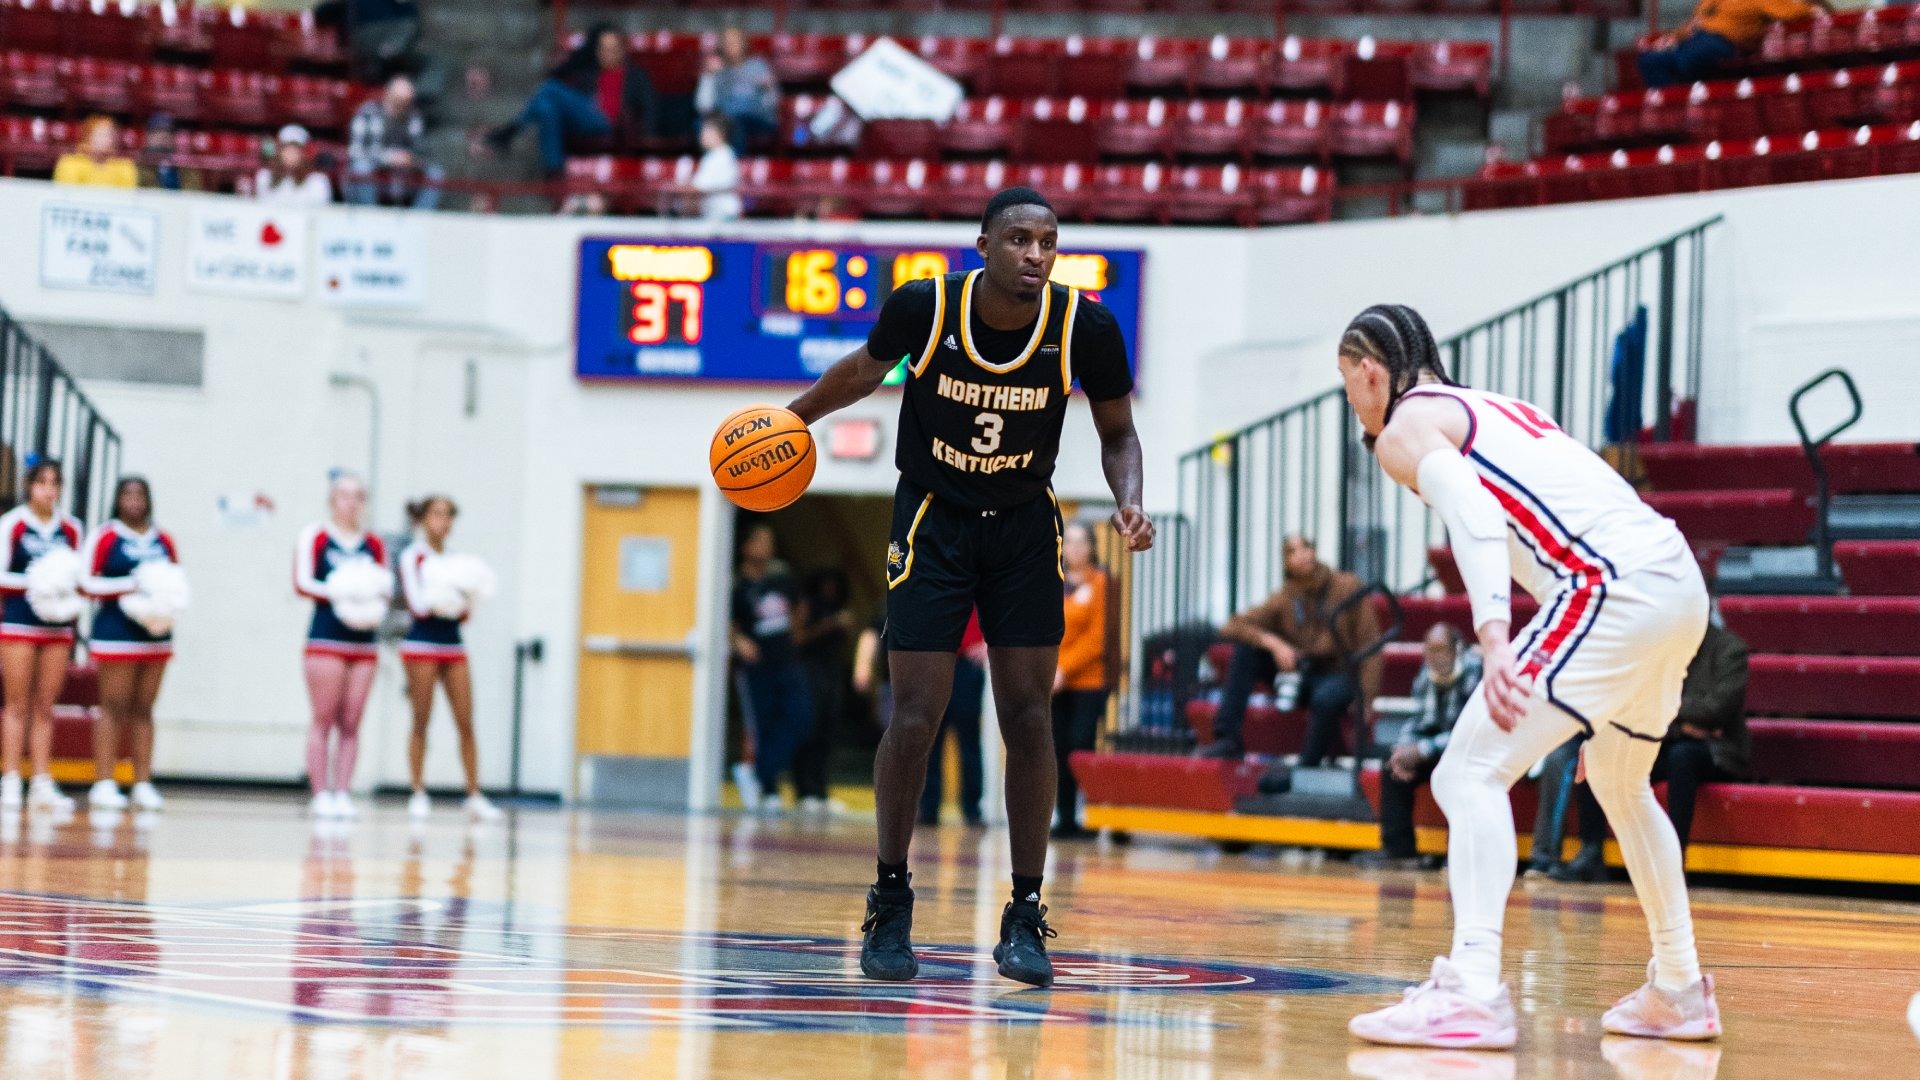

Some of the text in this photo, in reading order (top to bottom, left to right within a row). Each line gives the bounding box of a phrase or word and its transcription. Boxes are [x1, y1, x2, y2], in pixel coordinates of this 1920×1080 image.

[50, 206, 112, 229] TITAN
[66, 233, 109, 254] FAN
[89, 260, 147, 286] ZONE
[628, 280, 703, 345] 37
[937, 373, 1050, 411] NORTHERN
[724, 416, 772, 447] NCAA
[970, 412, 1004, 454] 3
[727, 440, 798, 478] Wilson
[932, 437, 1033, 474] KENTUCKY
